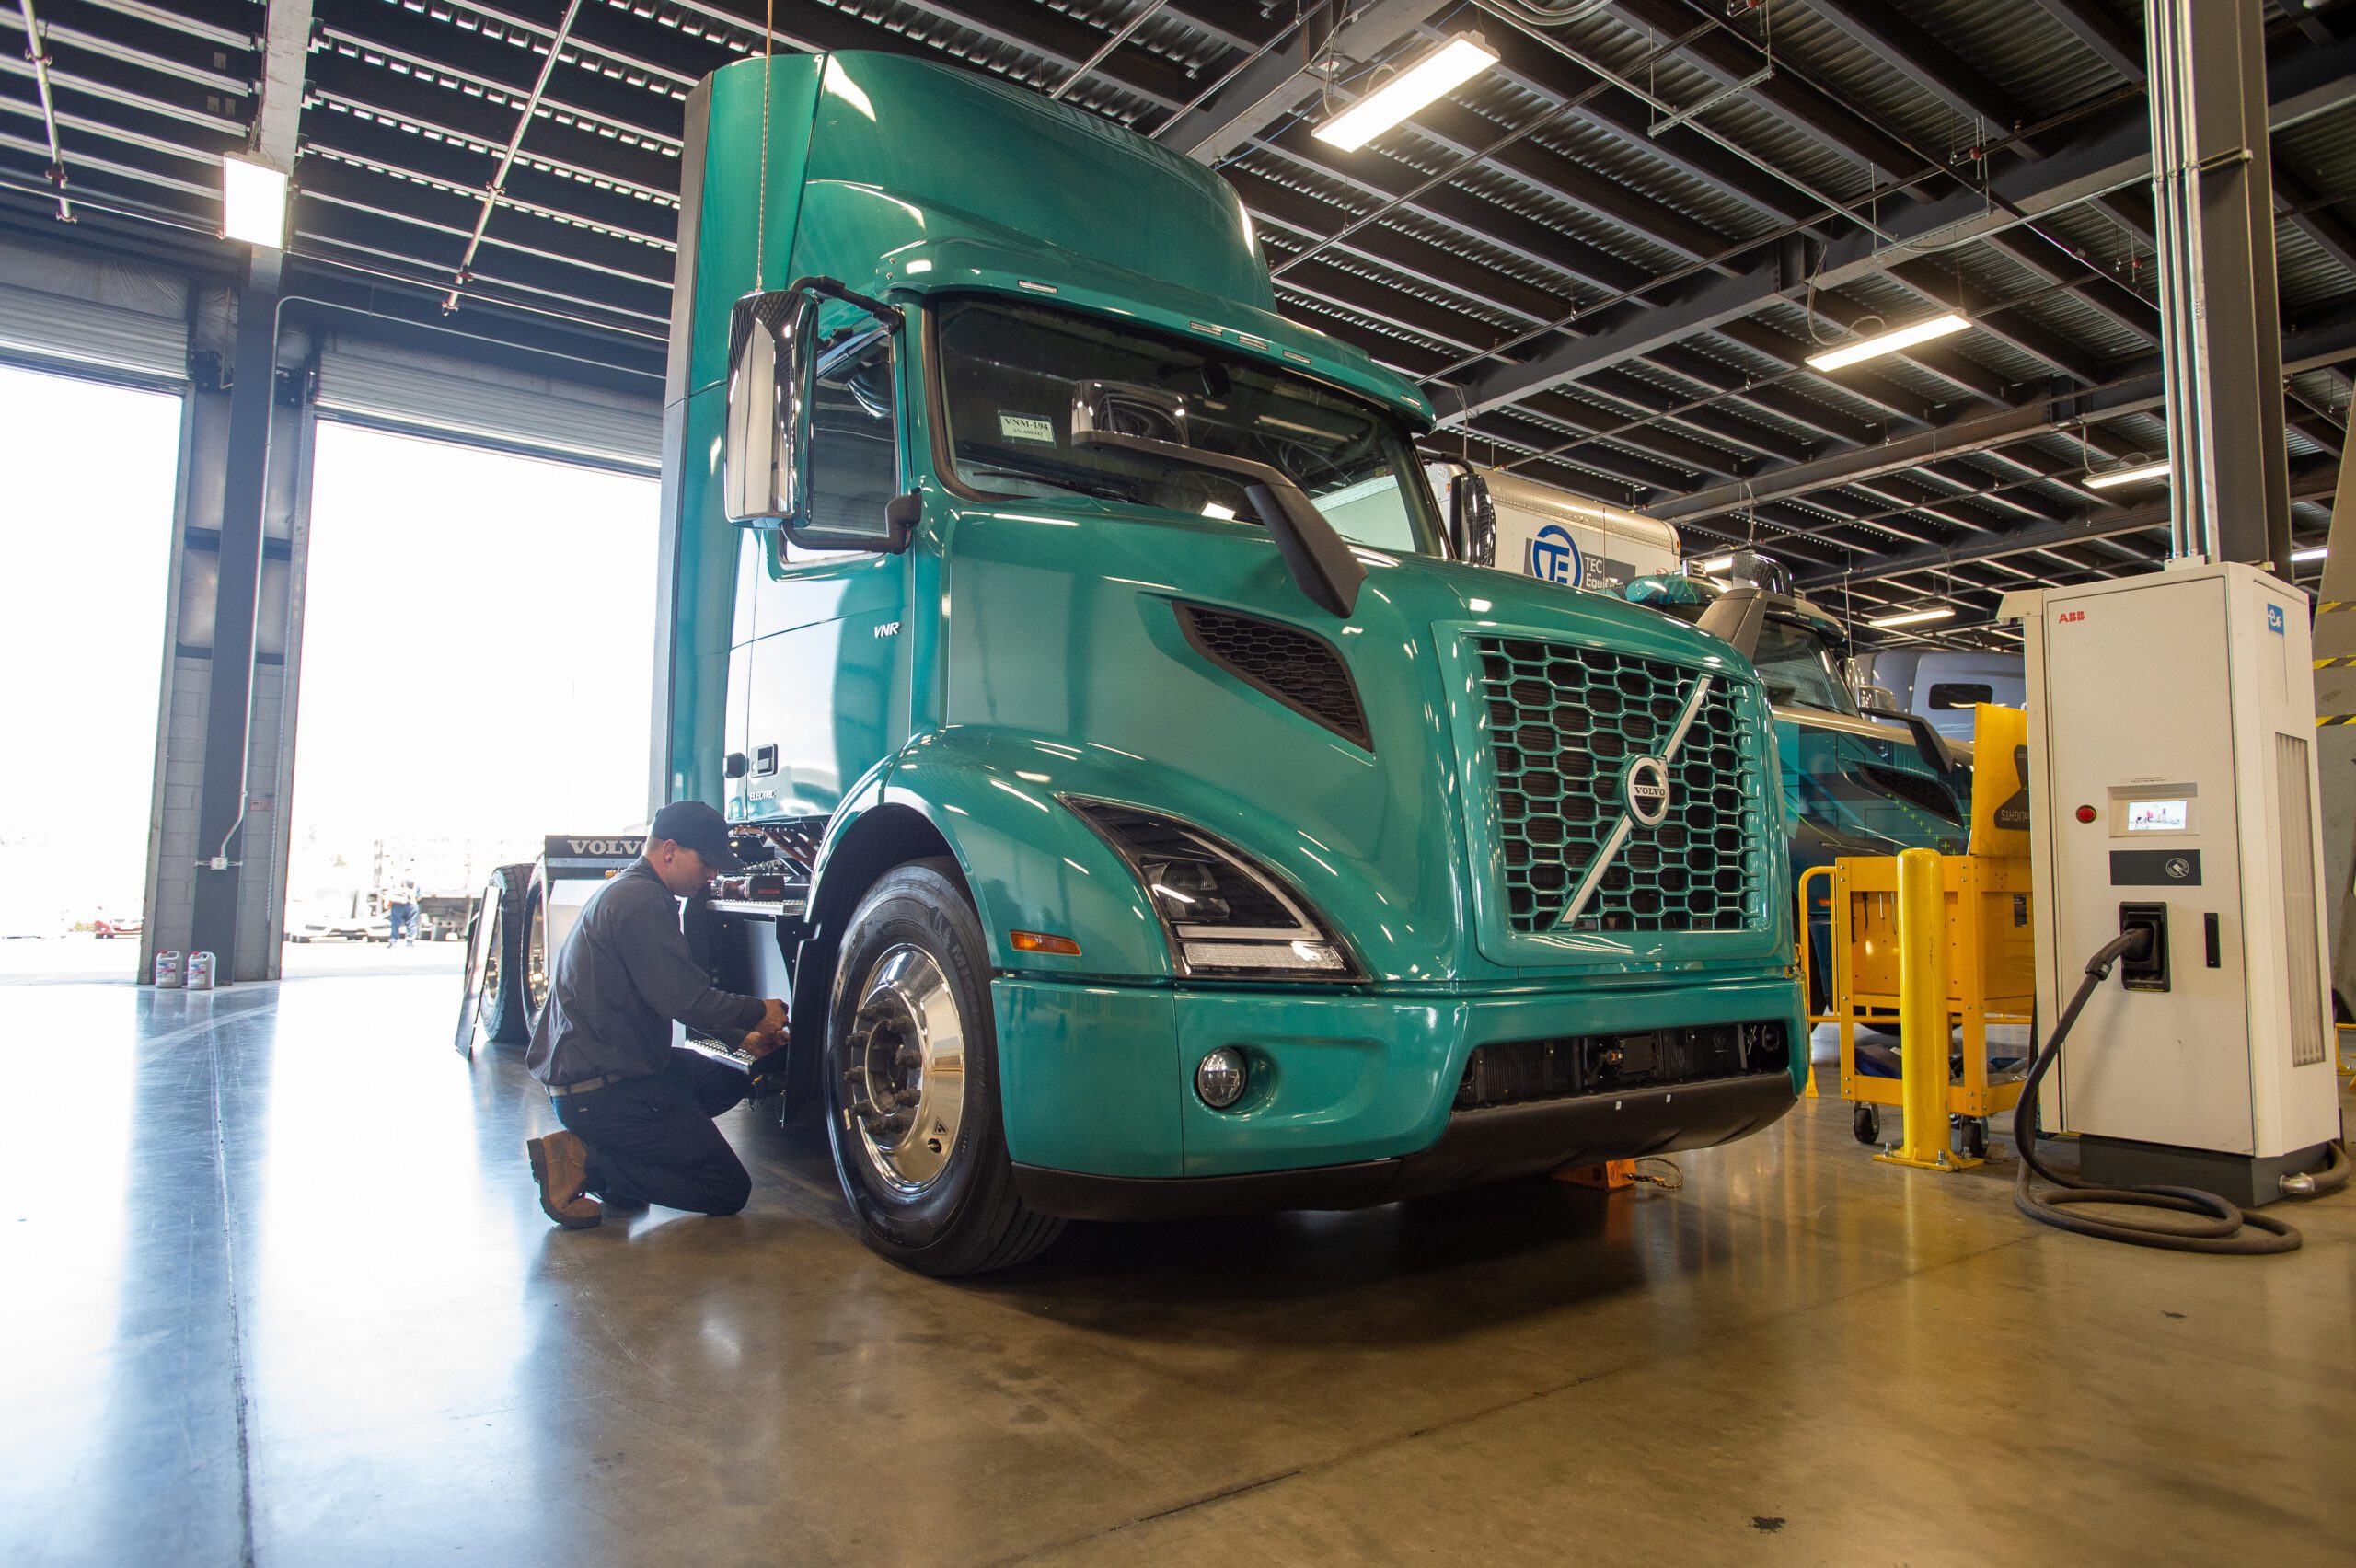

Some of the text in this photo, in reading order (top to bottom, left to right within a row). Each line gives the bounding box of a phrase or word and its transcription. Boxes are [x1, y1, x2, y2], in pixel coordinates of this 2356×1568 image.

[1004, 418, 1048, 431] VNM-194
[1585, 557, 1603, 574] TEC
[2058, 611, 2085, 624] ABB
[873, 622, 900, 639] VNR
[1634, 786, 1665, 797] VOLVO
[567, 840, 646, 855] VOLV
